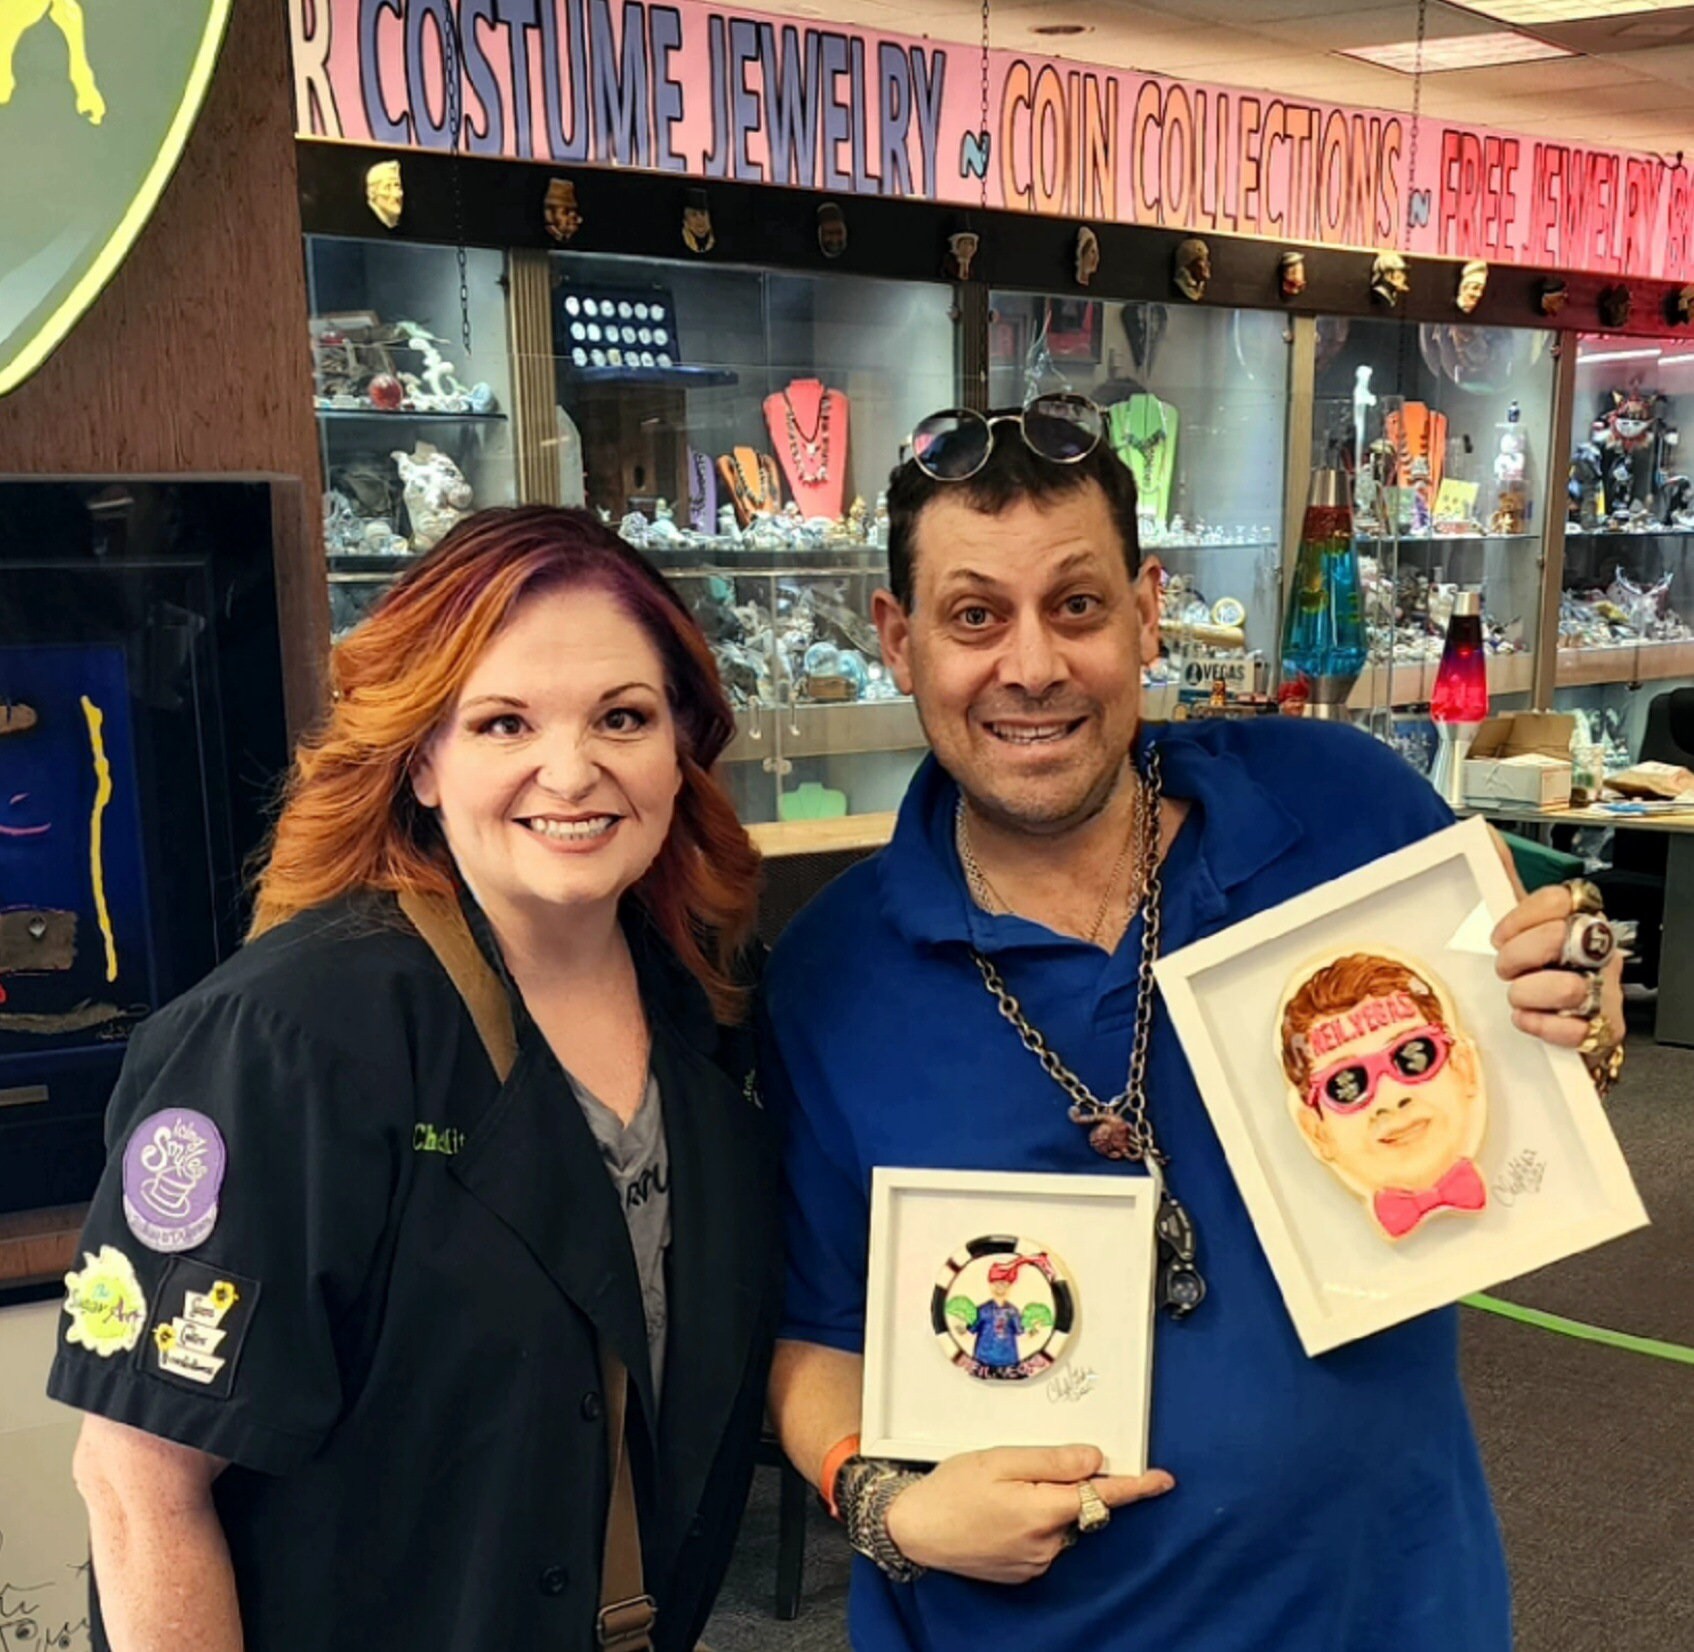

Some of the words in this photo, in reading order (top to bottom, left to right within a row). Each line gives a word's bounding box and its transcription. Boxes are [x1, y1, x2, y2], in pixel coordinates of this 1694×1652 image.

[358, 0, 687, 171] COSTUME
[704, 14, 946, 198] JEWELRY
[1000, 59, 1118, 221] COIN
[1132, 80, 1400, 248] COLLECTIONS
[1438, 129, 1519, 261] FREE
[1521, 142, 1664, 276] JEWELRY
